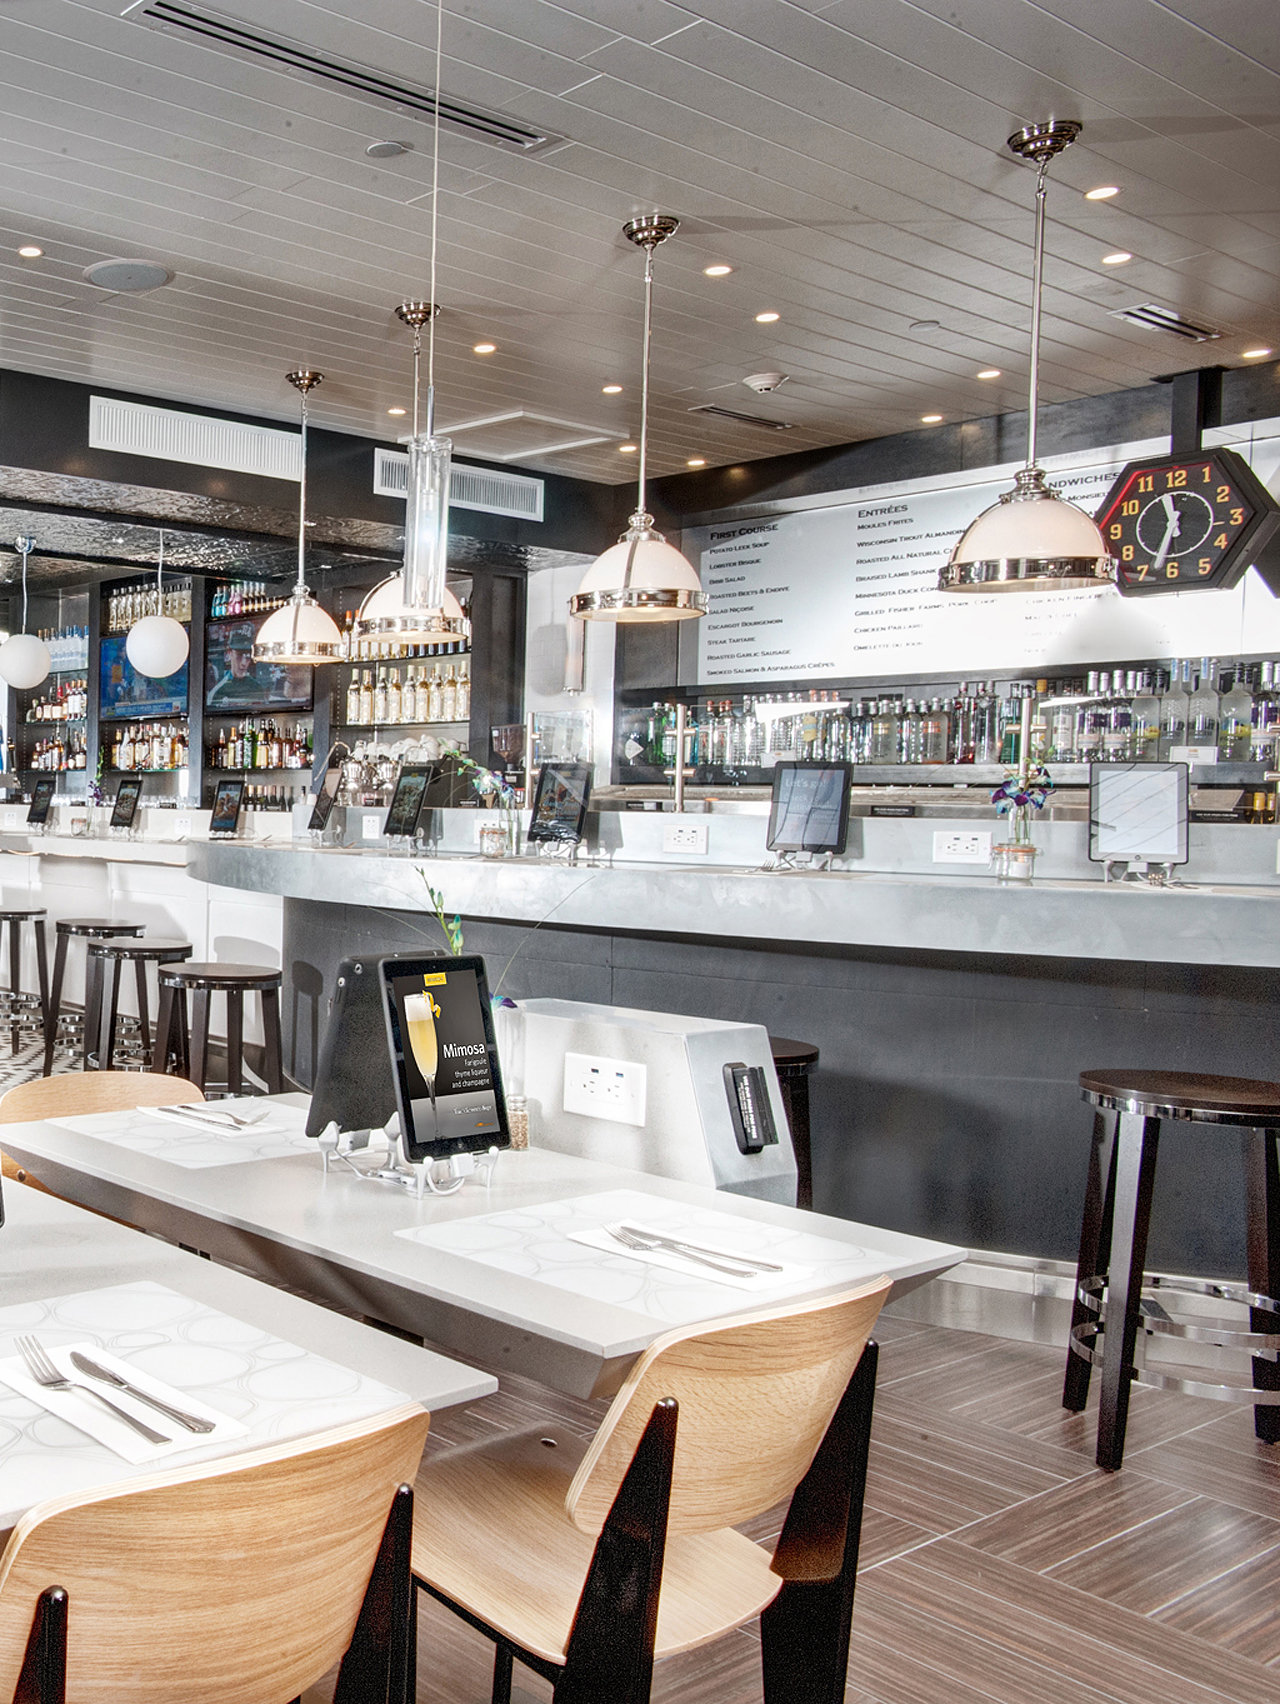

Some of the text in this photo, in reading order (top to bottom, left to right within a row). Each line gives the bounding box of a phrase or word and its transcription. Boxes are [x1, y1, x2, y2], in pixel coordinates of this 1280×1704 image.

[1048, 471, 1120, 488] NDWICHES
[1166, 470, 1187, 488] 12
[1202, 466, 1211, 483] 1
[1138, 475, 1154, 493] 11
[1216, 485, 1230, 503] 2
[858, 504, 908, 518] ENTRÉES
[1121, 499, 1140, 516] 10
[857, 518, 914, 530] MOULES FRITES
[1229, 507, 1244, 525] 3
[710, 524, 778, 540] FIRST COURSE
[856, 529, 966, 548] WISCONSIN TROUT ALMANDIN
[1110, 523, 1122, 540] 9
[1213, 533, 1228, 549] 4
[856, 556, 889, 565] ROASTED
[890, 553, 905, 561] ALL
[906, 550, 942, 558] NATURAL
[1122, 545, 1134, 561] 8
[709, 561, 737, 570] LOBSTER
[1137, 564, 1149, 581] 7
[1166, 561, 1179, 578] 6
[1198, 558, 1212, 575] 5
[725, 575, 746, 583] SALAD
[855, 568, 936, 582] BRAISED LAMB SHANK
[855, 591, 896, 599] MINNESOTA
[708, 622, 740, 630] ESCARGOT
[707, 653, 735, 661] ROASTED
[767, 663, 806, 671] ASPARAGUS
[443, 1043, 485, 1059] Mimosa
